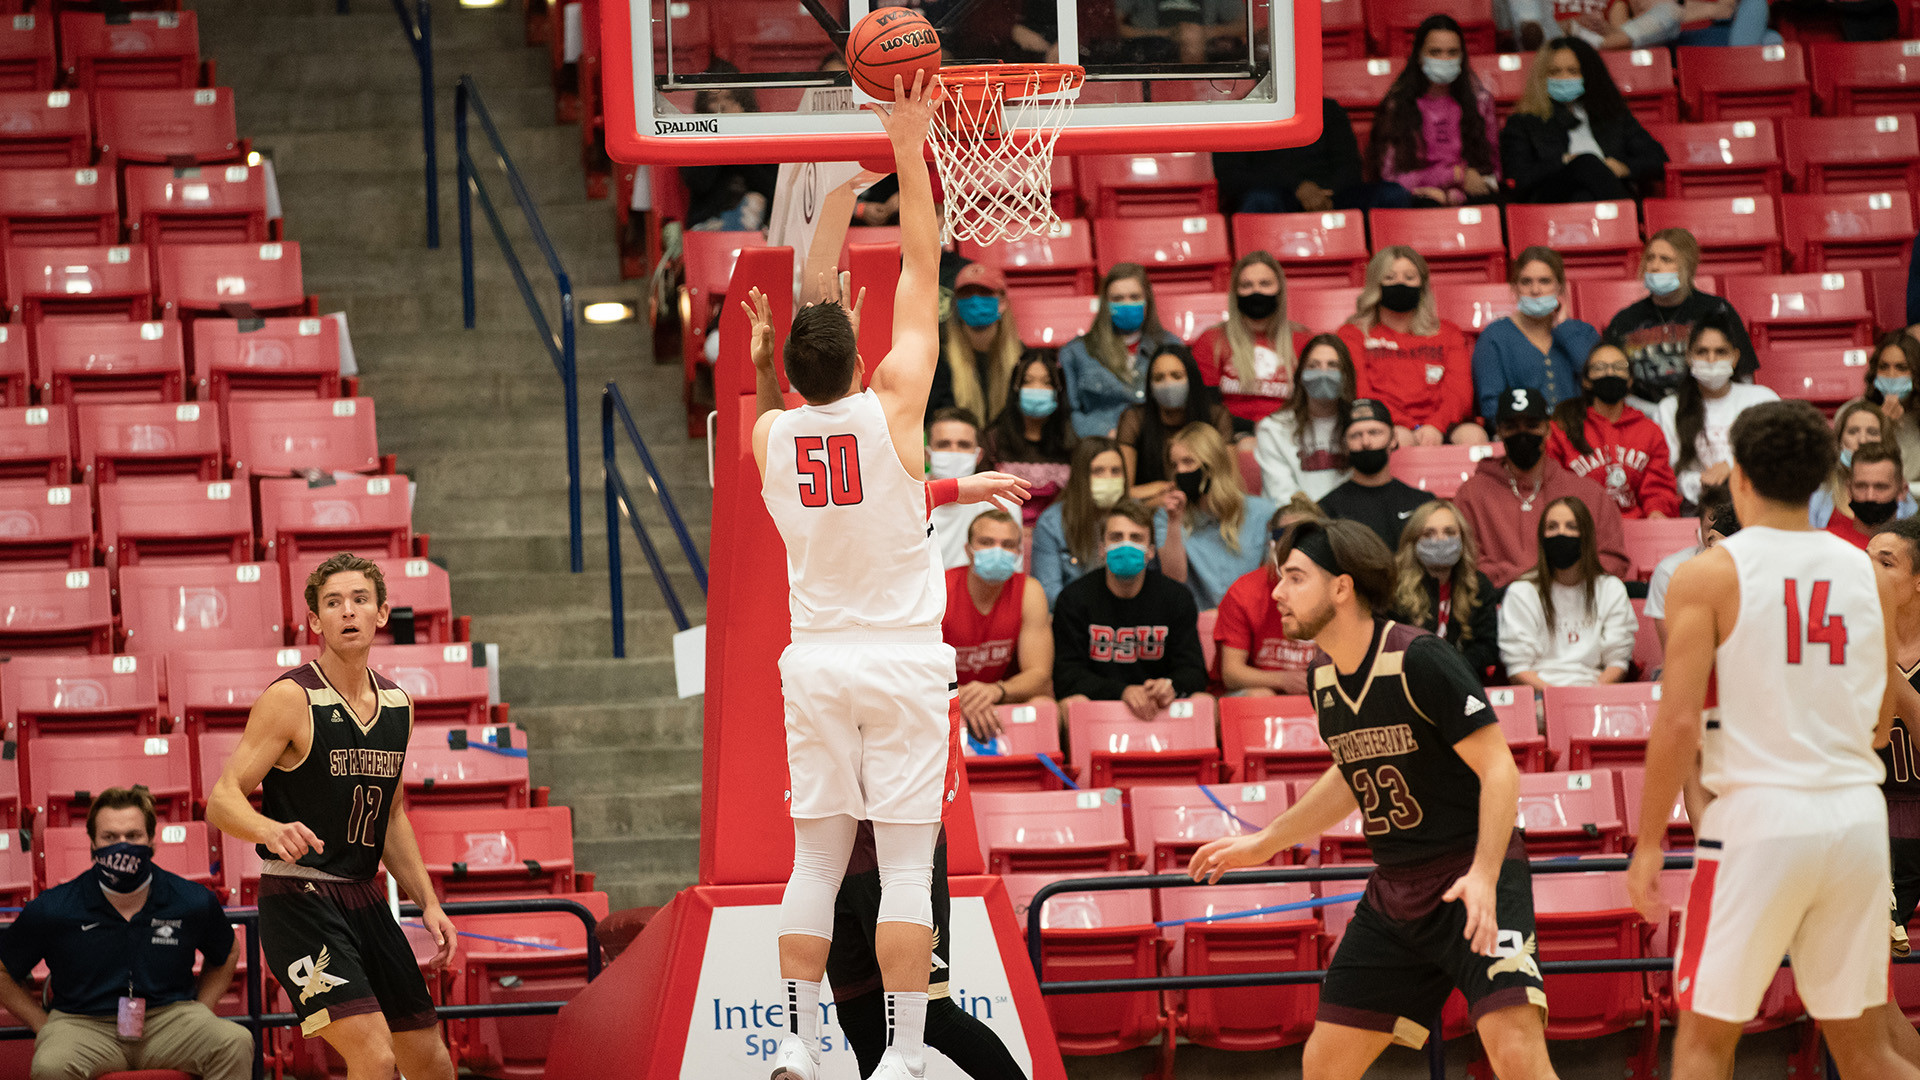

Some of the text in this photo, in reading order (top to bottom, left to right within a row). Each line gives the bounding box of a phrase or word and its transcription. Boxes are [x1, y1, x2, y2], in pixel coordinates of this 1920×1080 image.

[876, 10, 919, 27] NCAA
[880, 29, 937, 53] Wilson
[654, 118, 718, 135] SPALDING
[1511, 389, 1529, 411] 3
[794, 433, 863, 508] 50
[1784, 578, 1848, 665] 14
[1088, 624, 1169, 663] DSU
[329, 748, 348, 777] ST
[1342, 723, 1419, 763] KATHERINE
[347, 784, 383, 847] 12
[1352, 764, 1423, 836] 23
